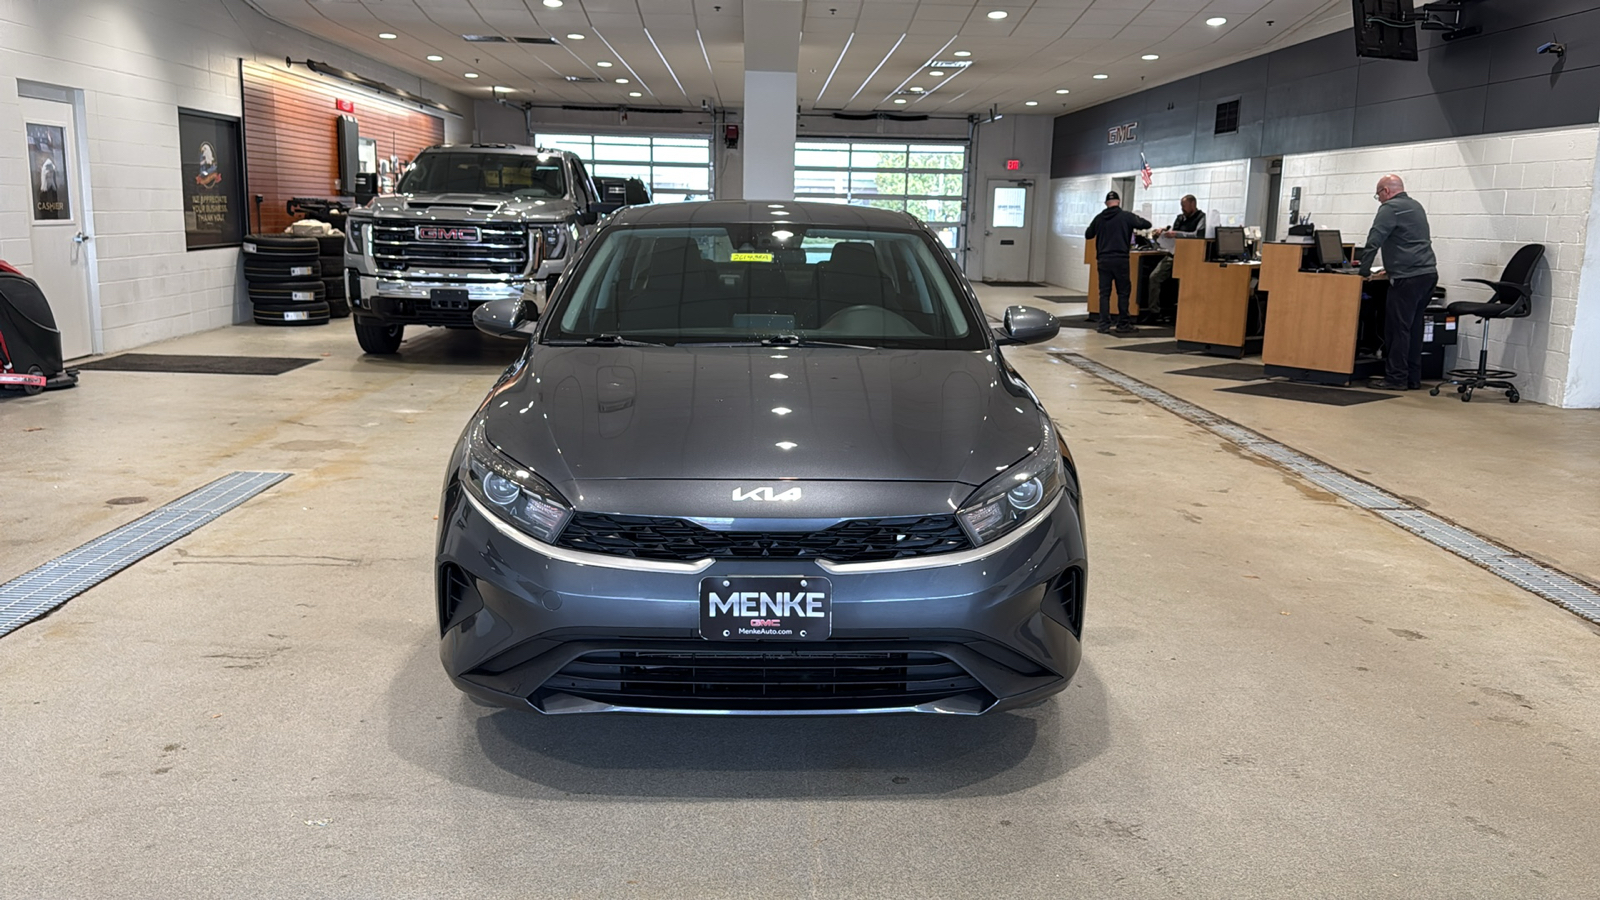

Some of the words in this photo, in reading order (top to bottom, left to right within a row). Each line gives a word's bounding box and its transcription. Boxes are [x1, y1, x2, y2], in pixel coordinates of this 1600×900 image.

[1108, 122, 1137, 146] GMC
[1007, 160, 1019, 170] EXIT
[37, 202, 64, 210] CASHIER
[197, 214, 213, 222] THANK
[420, 227, 476, 240] GMC
[732, 487, 802, 501] KIA
[709, 592, 825, 617] MENKE
[750, 619, 780, 627] GMC
